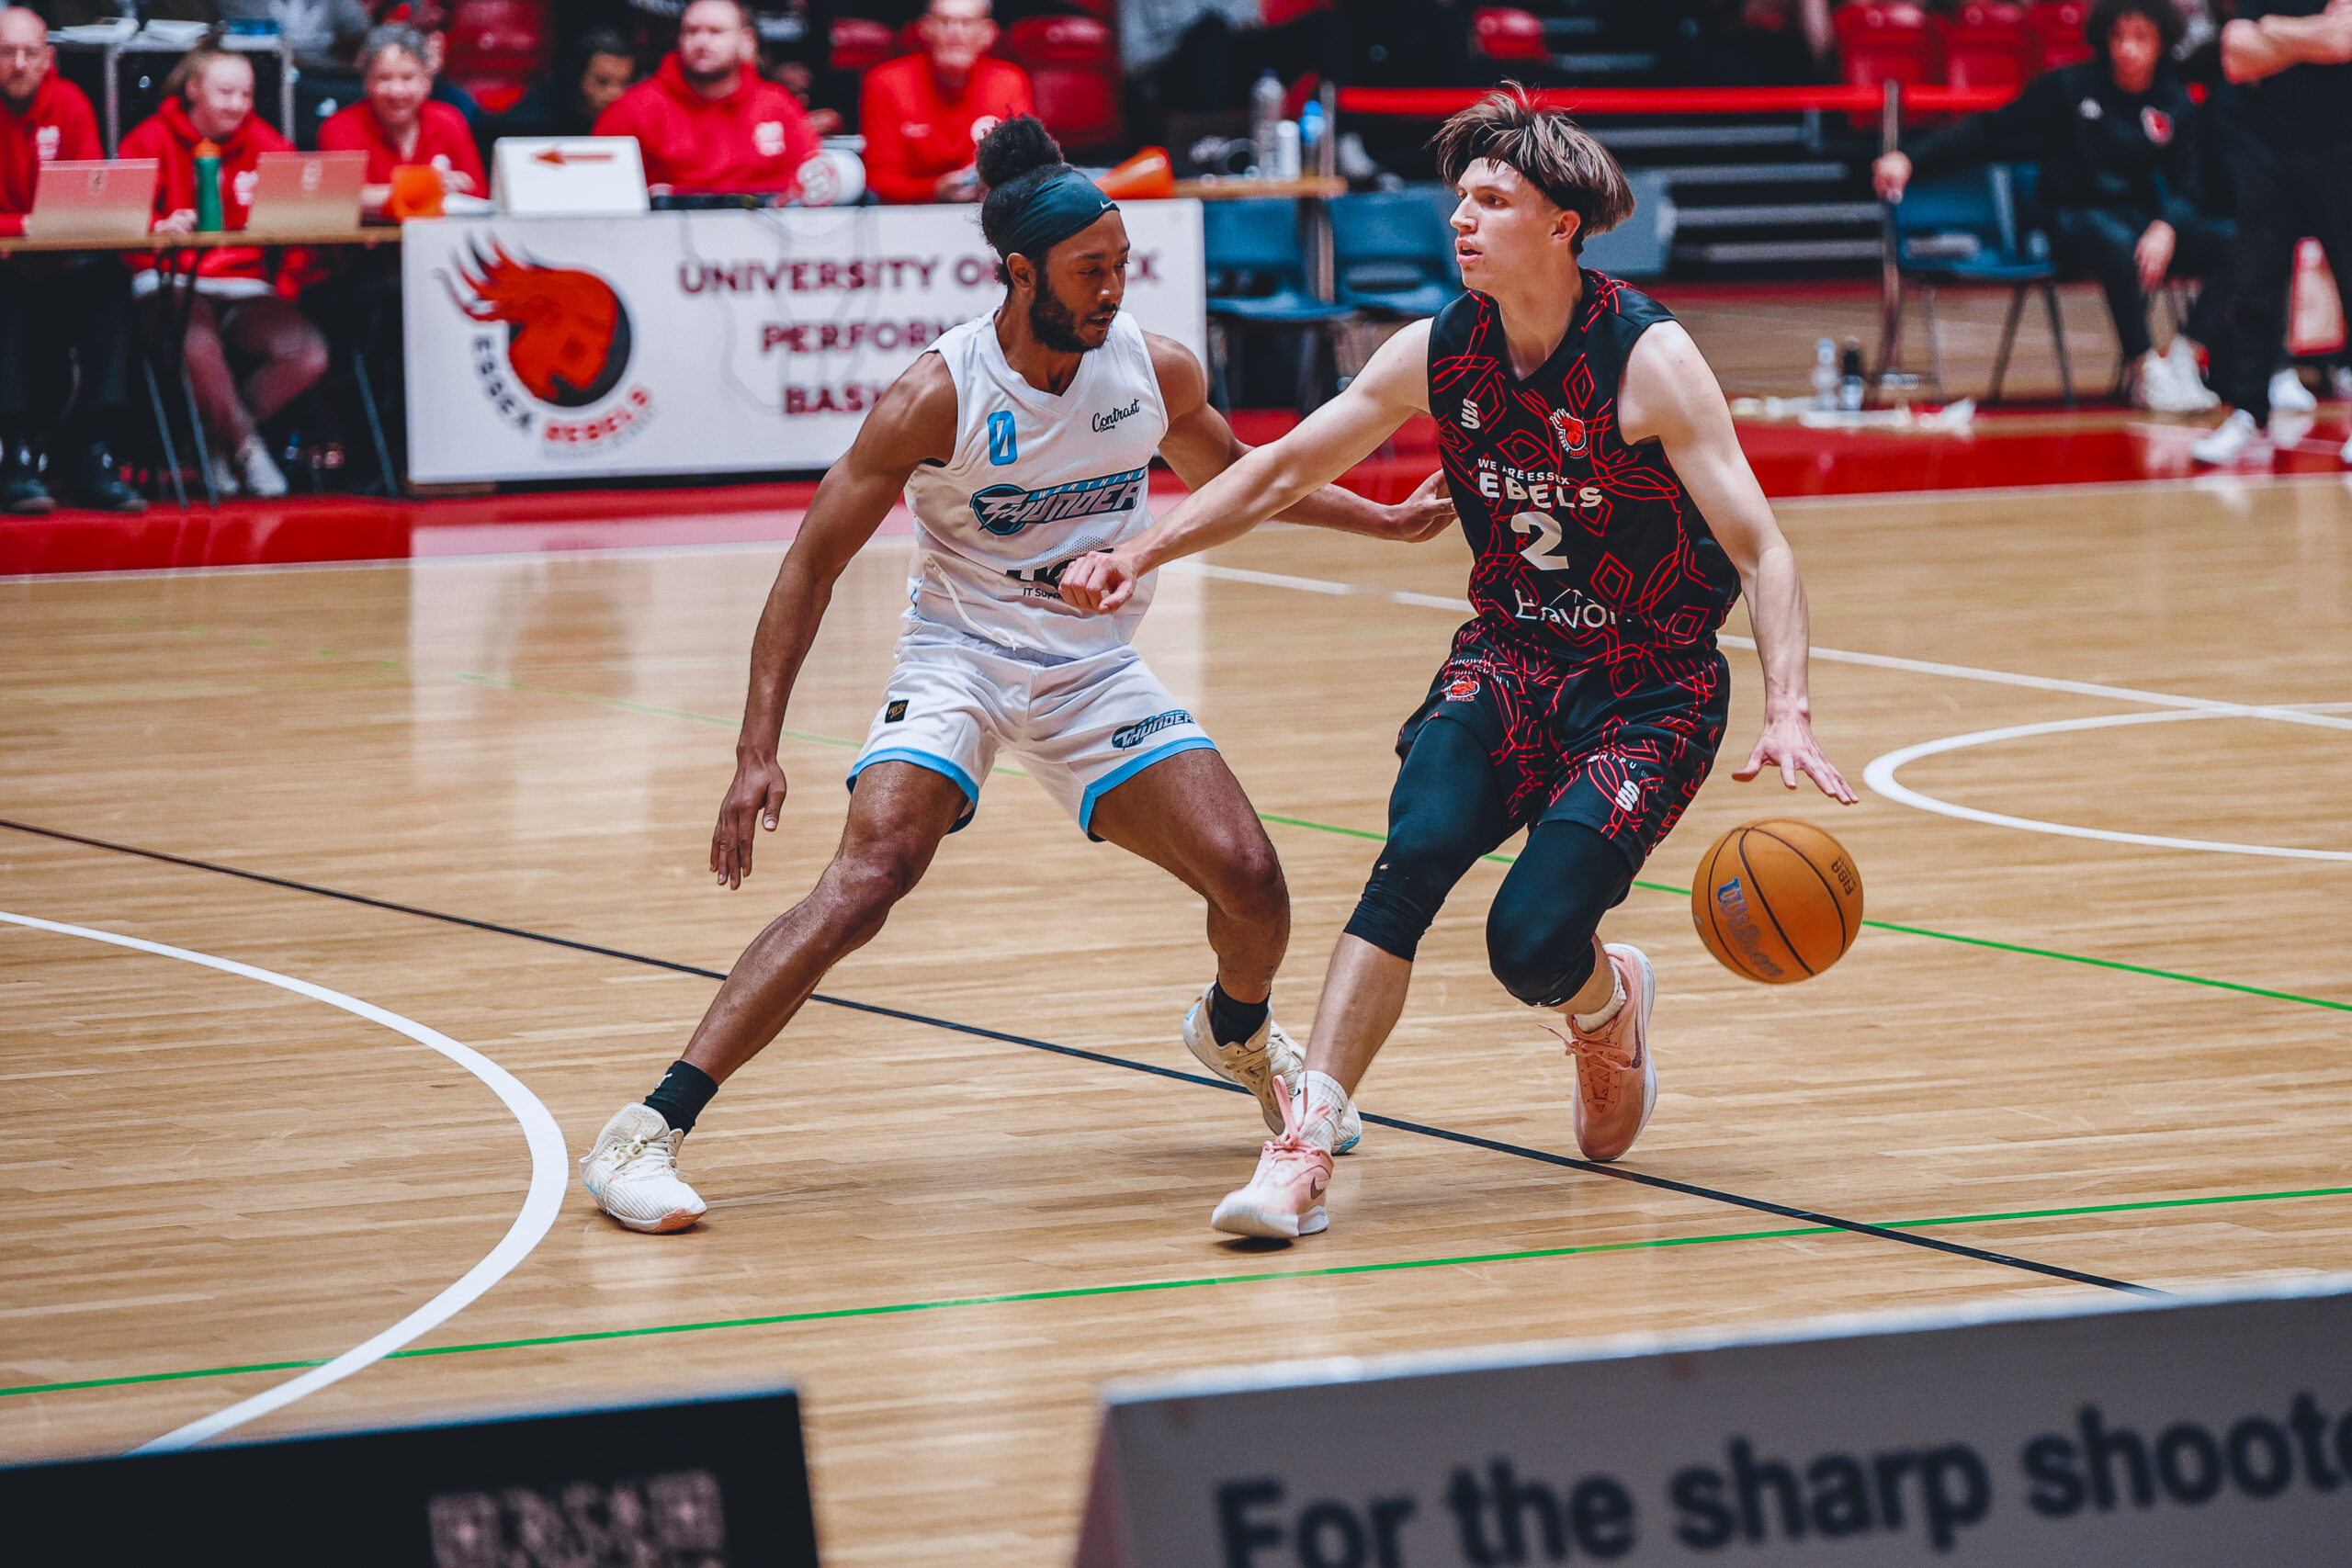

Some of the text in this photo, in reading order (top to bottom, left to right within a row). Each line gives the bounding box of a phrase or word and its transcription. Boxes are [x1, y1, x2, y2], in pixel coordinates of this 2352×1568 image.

[680, 259, 937, 293] UNIVERSITY
[987, 411, 1018, 466] 0
[1092, 398, 1140, 433] Contrast
[1477, 458, 1497, 470] WE
[976, 477, 1145, 533] THUNDER
[1510, 511, 1570, 571] 2
[1114, 712, 1195, 748] THUNDER
[1717, 876, 1785, 977] Wilson
[1215, 1392, 2352, 1568] For the sharp shoot
